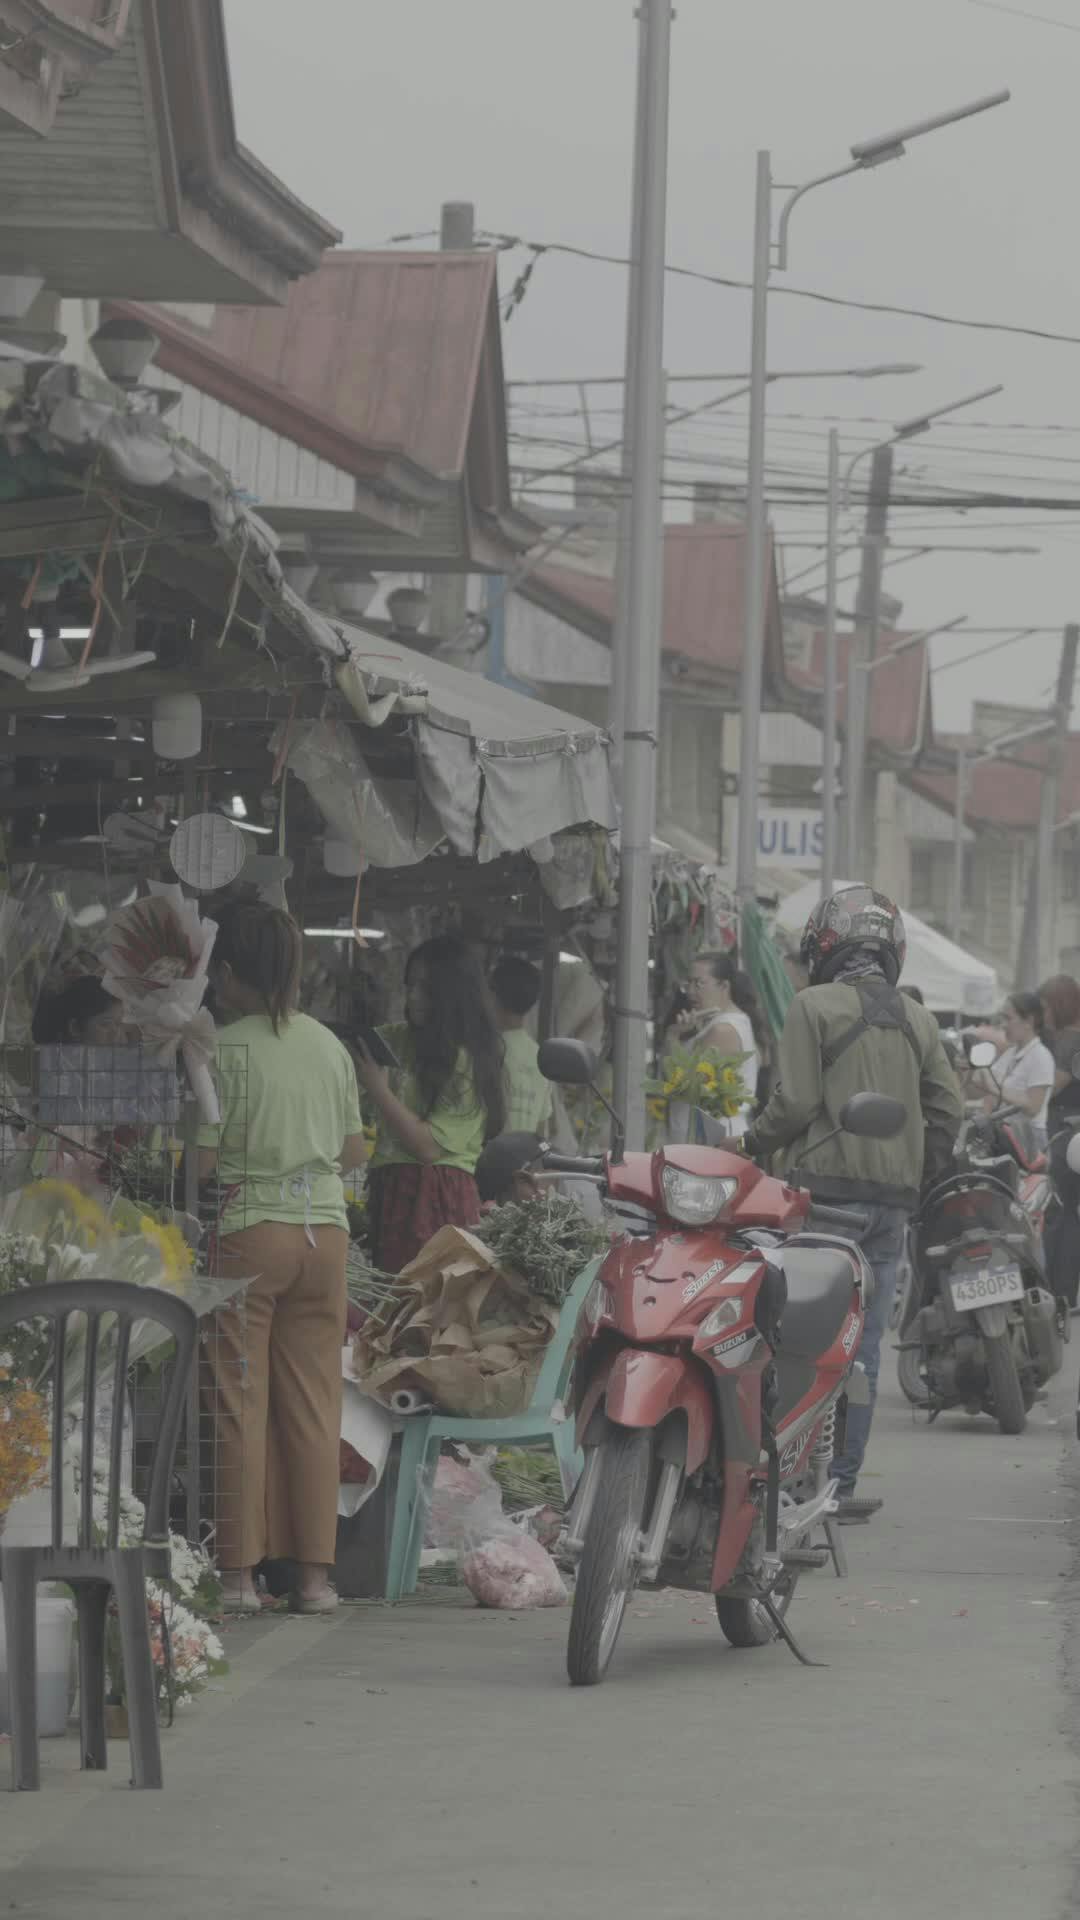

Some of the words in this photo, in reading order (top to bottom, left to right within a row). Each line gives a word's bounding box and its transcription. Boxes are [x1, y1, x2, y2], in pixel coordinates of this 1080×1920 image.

[680, 1258, 726, 1304] Smash
[957, 1273, 1018, 1300] 4380PS
[713, 1331, 747, 1355] SUZUKI
